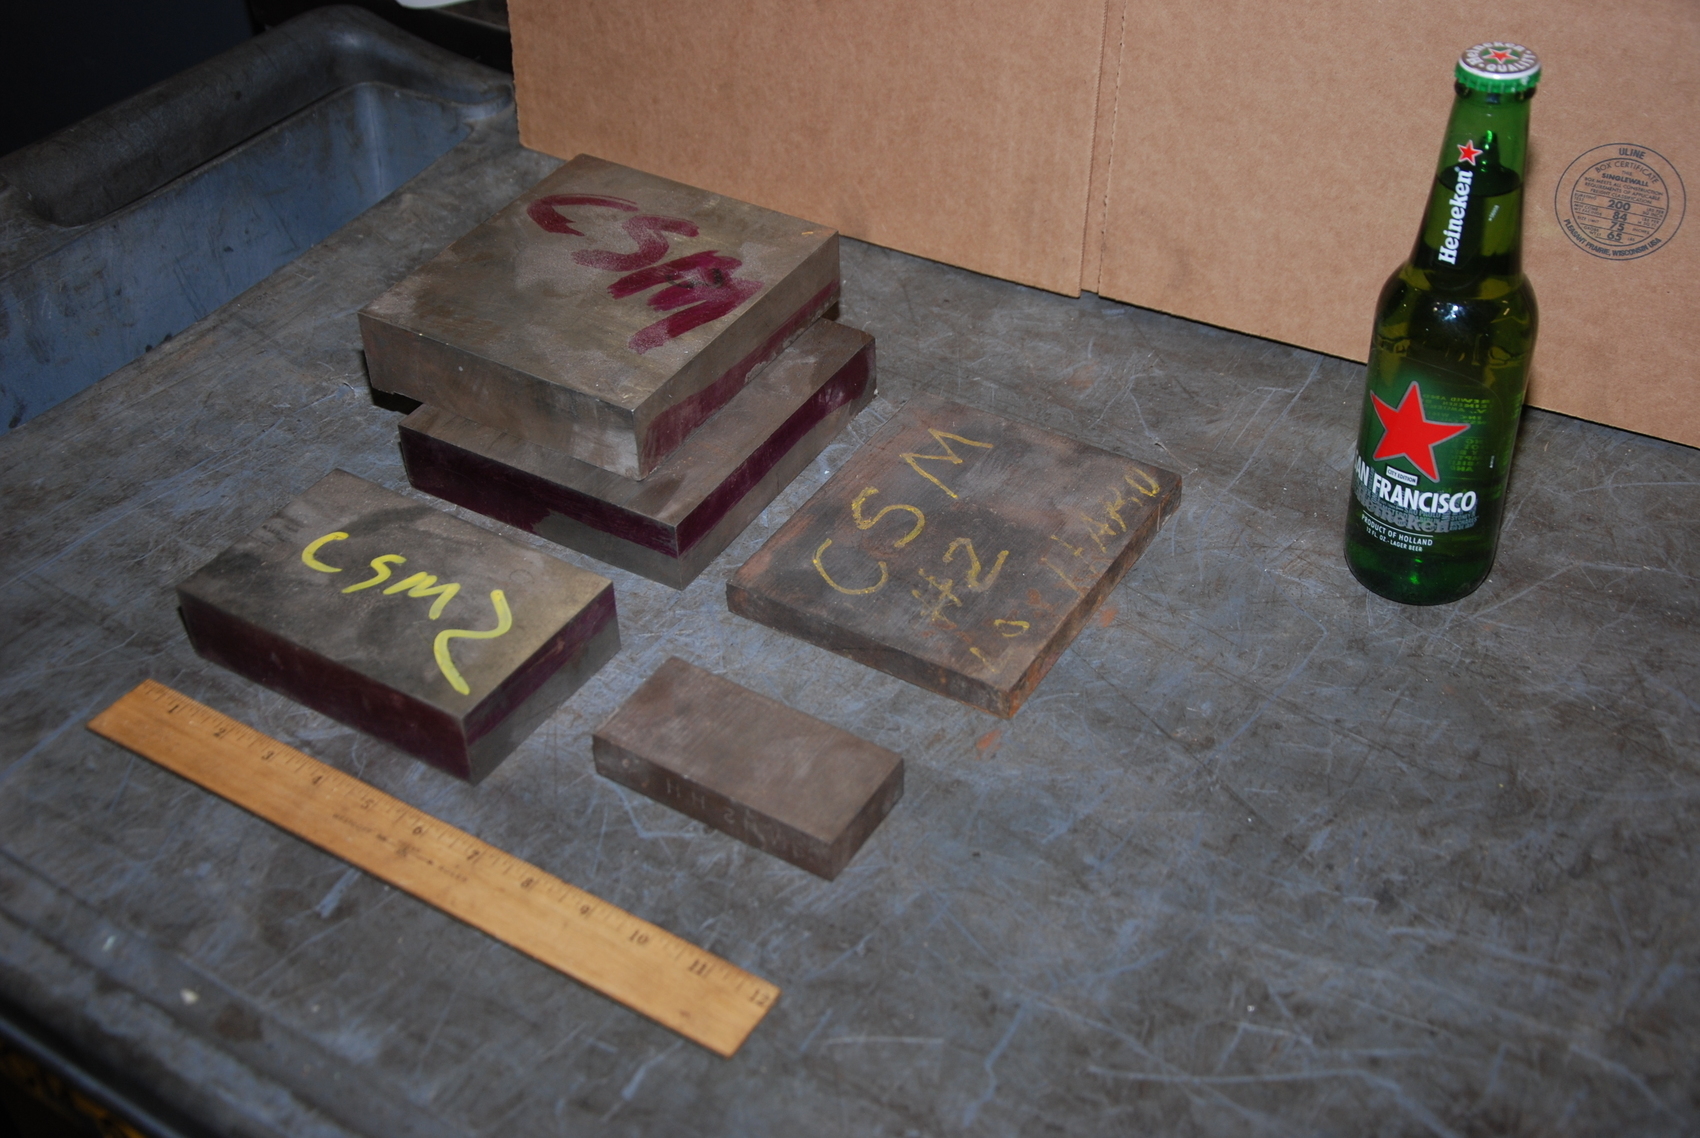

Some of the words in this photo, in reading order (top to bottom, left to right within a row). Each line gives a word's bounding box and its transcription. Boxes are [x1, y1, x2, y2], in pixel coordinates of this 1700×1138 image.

[1486, 53, 1537, 72] QUALITY
[1618, 147, 1646, 160] ULINE
[1594, 162, 1611, 173] BOX
[1614, 160, 1659, 185] CERTIFICATE
[1601, 172, 1649, 187] SINGLEWALL
[1584, 181, 1622, 193] REQUIREMENTS
[1623, 184, 1664, 196] CONSTRUCTION
[1590, 188, 1611, 196] FREIGHT
[1611, 192, 1653, 205] CLASSIFICATION
[1607, 199, 1631, 211] 200
[1438, 168, 1474, 265] Heineken
[1612, 211, 1628, 222] 84
[1609, 220, 1625, 232] 75
[1563, 218, 1588, 245] PLEASANT
[1585, 241, 1611, 256] PRAIRIE,
[1612, 244, 1649, 256] WISCONSIN
[1648, 237, 1662, 248] USA
[1606, 231, 1623, 242] 65
[527, 193, 764, 355] CSM
[1387, 468, 1397, 478] CITY
[1397, 472, 1416, 484] EDITION
[1372, 471, 1477, 514] FRANCISCO
[813, 428, 993, 595] CSM
[1361, 513, 1387, 534] PRODUCT
[1387, 529, 1398, 538] OF
[1398, 533, 1433, 546] HOLLAND
[1389, 539, 1408, 550] LAGER
[1408, 545, 1423, 553] BEER
[213, 727, 226, 738] 2
[261, 751, 275, 761] 3
[312, 775, 323, 785] 4
[360, 799, 374, 810] 5
[412, 826, 422, 836] 6
[521, 878, 535, 888] 8
[579, 905, 591, 915] 9
[629, 929, 649, 945] 10
[688, 959, 710, 976] 11
[748, 989, 770, 1006] 12
